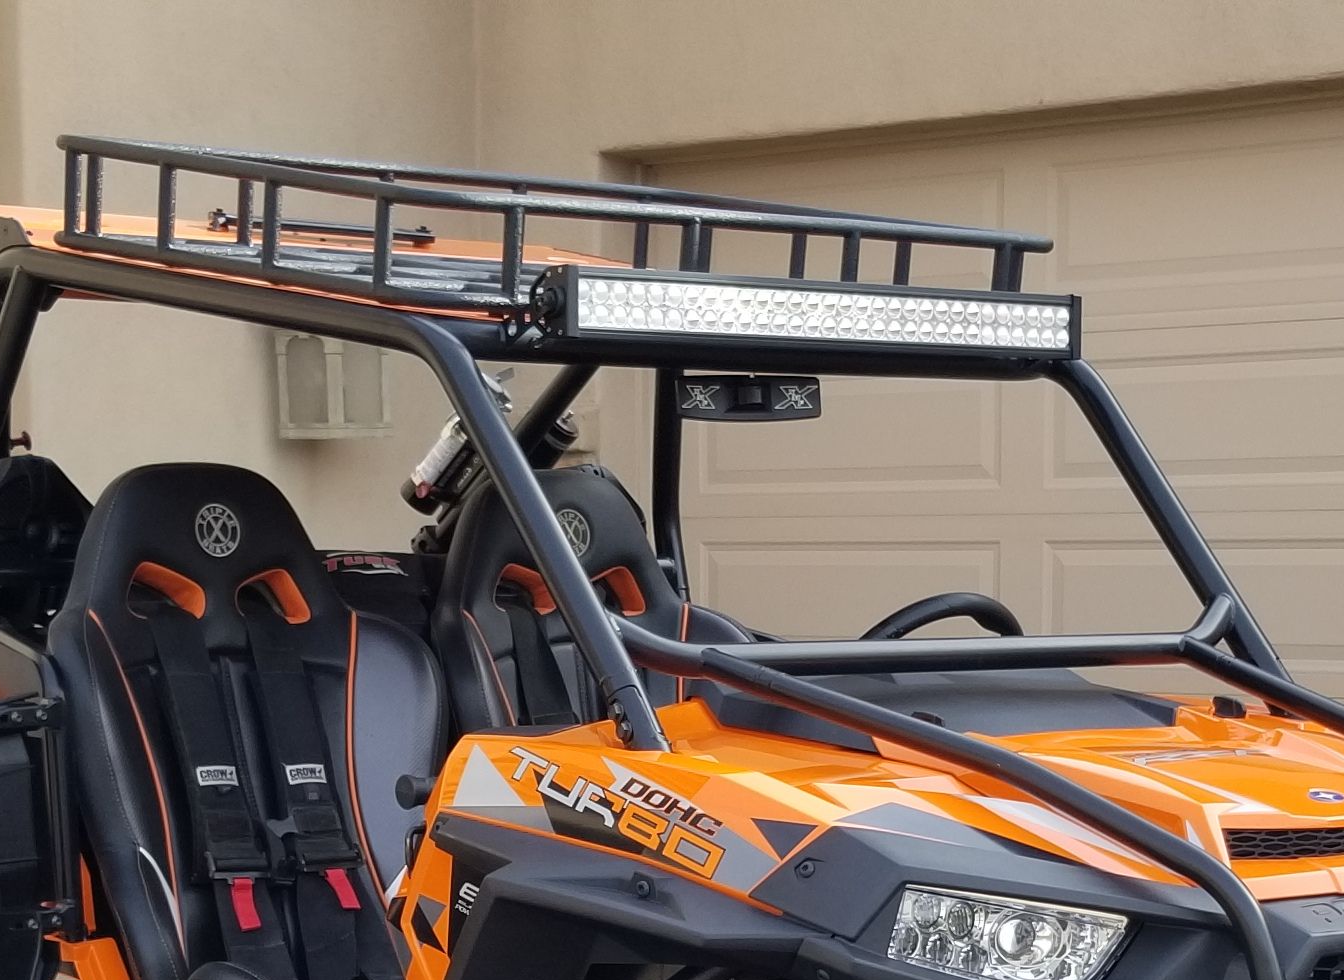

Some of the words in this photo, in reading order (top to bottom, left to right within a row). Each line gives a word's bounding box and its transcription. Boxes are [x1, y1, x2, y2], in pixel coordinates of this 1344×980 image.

[197, 507, 236, 527] TRIPLE
[199, 769, 227, 779] CROW
[289, 767, 317, 778] CROW
[509, 746, 726, 880] TURBO
[620, 777, 723, 837] DOHC
